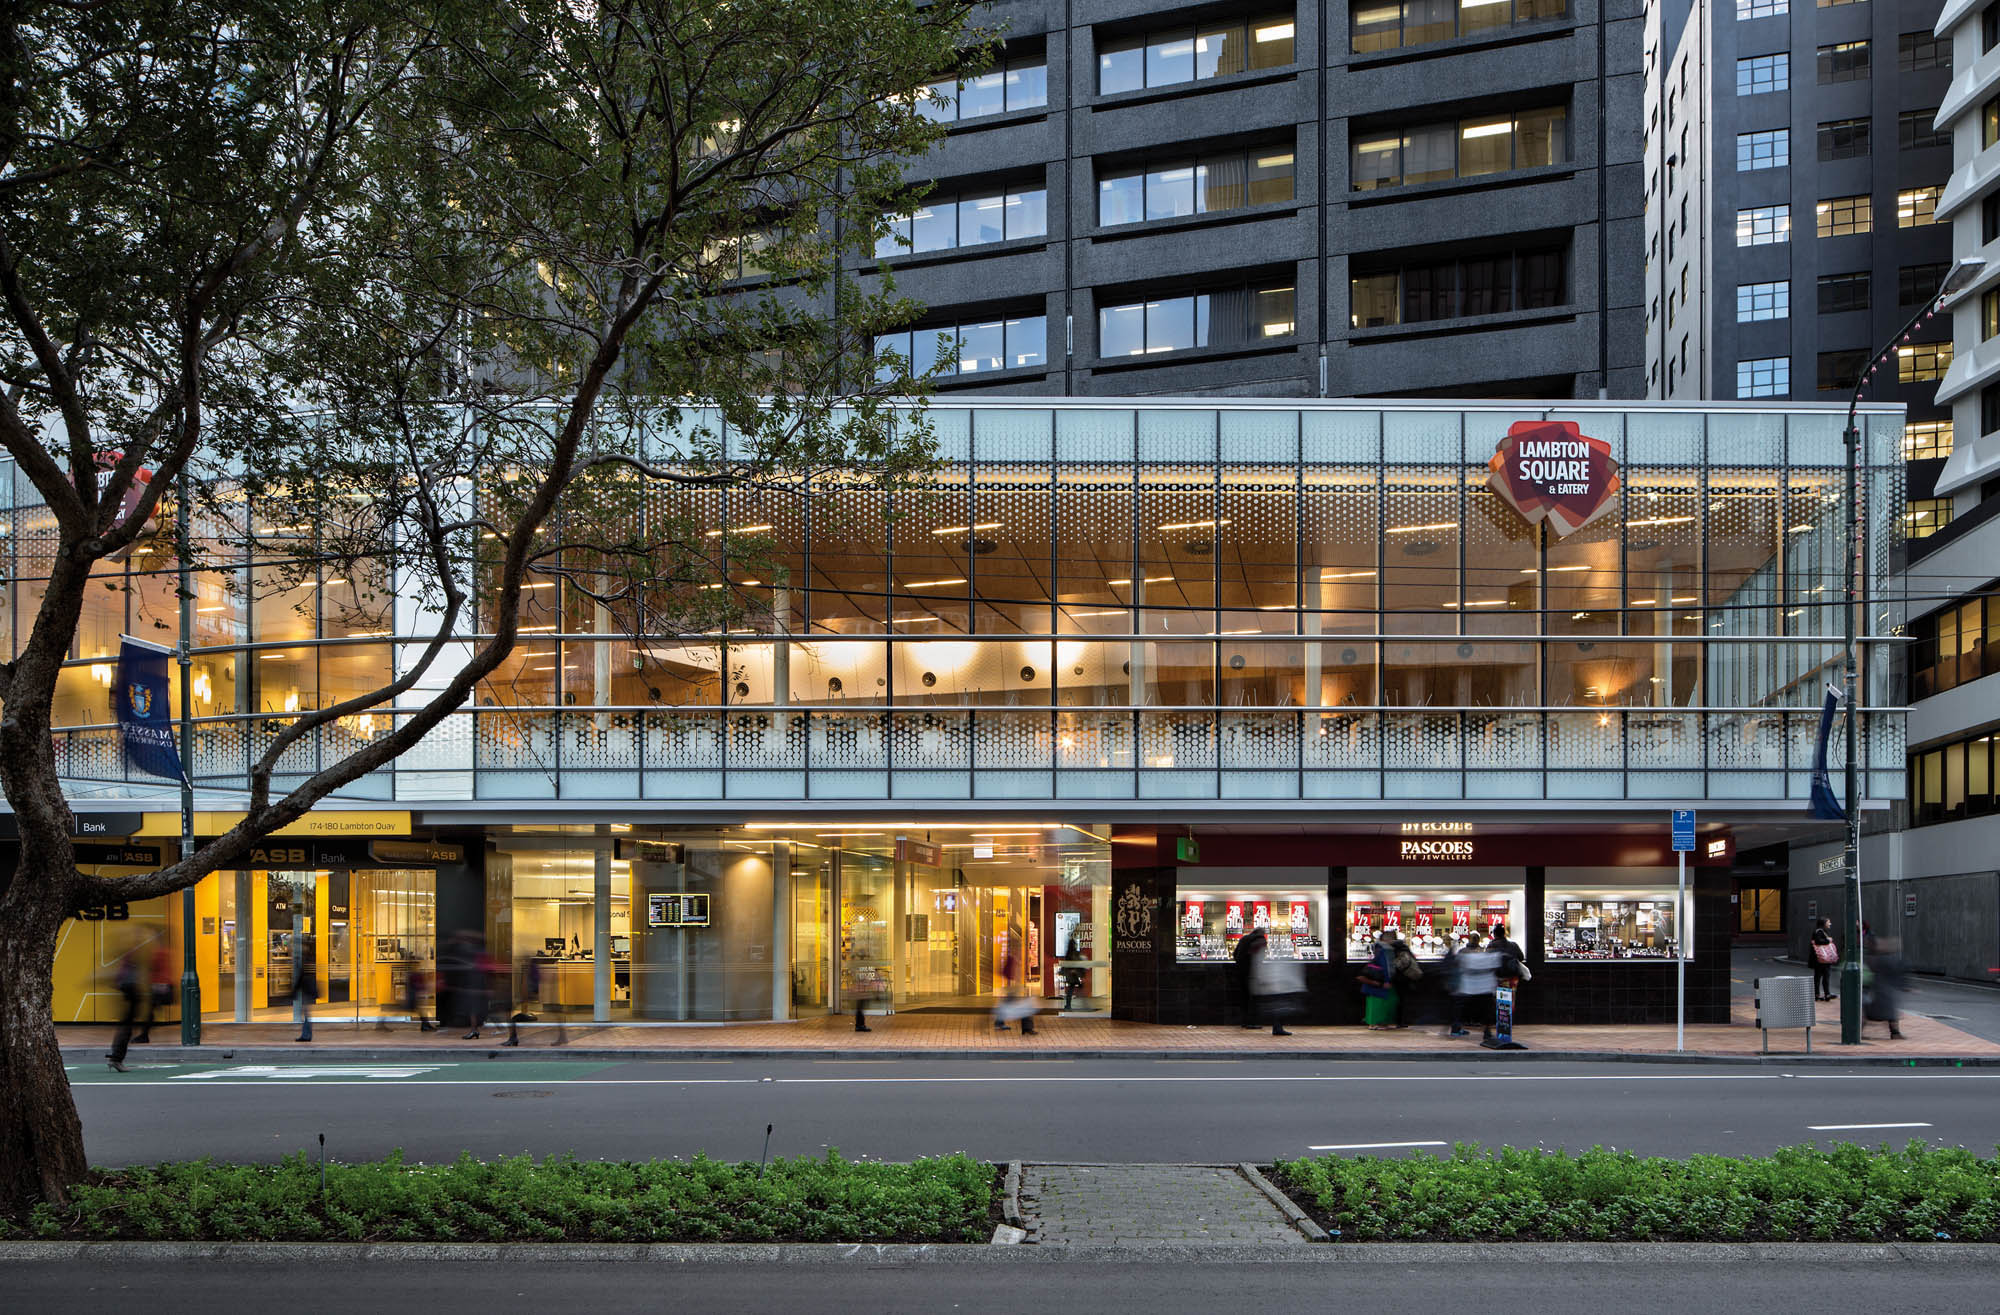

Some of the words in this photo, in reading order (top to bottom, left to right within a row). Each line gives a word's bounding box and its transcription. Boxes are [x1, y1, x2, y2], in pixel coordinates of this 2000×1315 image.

[1519, 441, 1589, 458] LAMBTON
[1519, 460, 1589, 484] SQUARE
[1549, 485, 1556, 494] &
[1558, 483, 1589, 494] EATERY
[1680, 811, 1687, 820] P
[83, 823, 106, 832] Bank
[310, 823, 339, 831] 174-180
[340, 822, 374, 831] Lambton
[376, 823, 396, 833] Quay
[1401, 841, 1473, 854] PASCOES
[123, 853, 153, 863] ASB
[250, 849, 305, 863] ASB
[322, 854, 346, 863] Bank
[431, 850, 457, 861] ASB
[332, 905, 347, 913] Change
[1117, 941, 1151, 949] PASCOES
